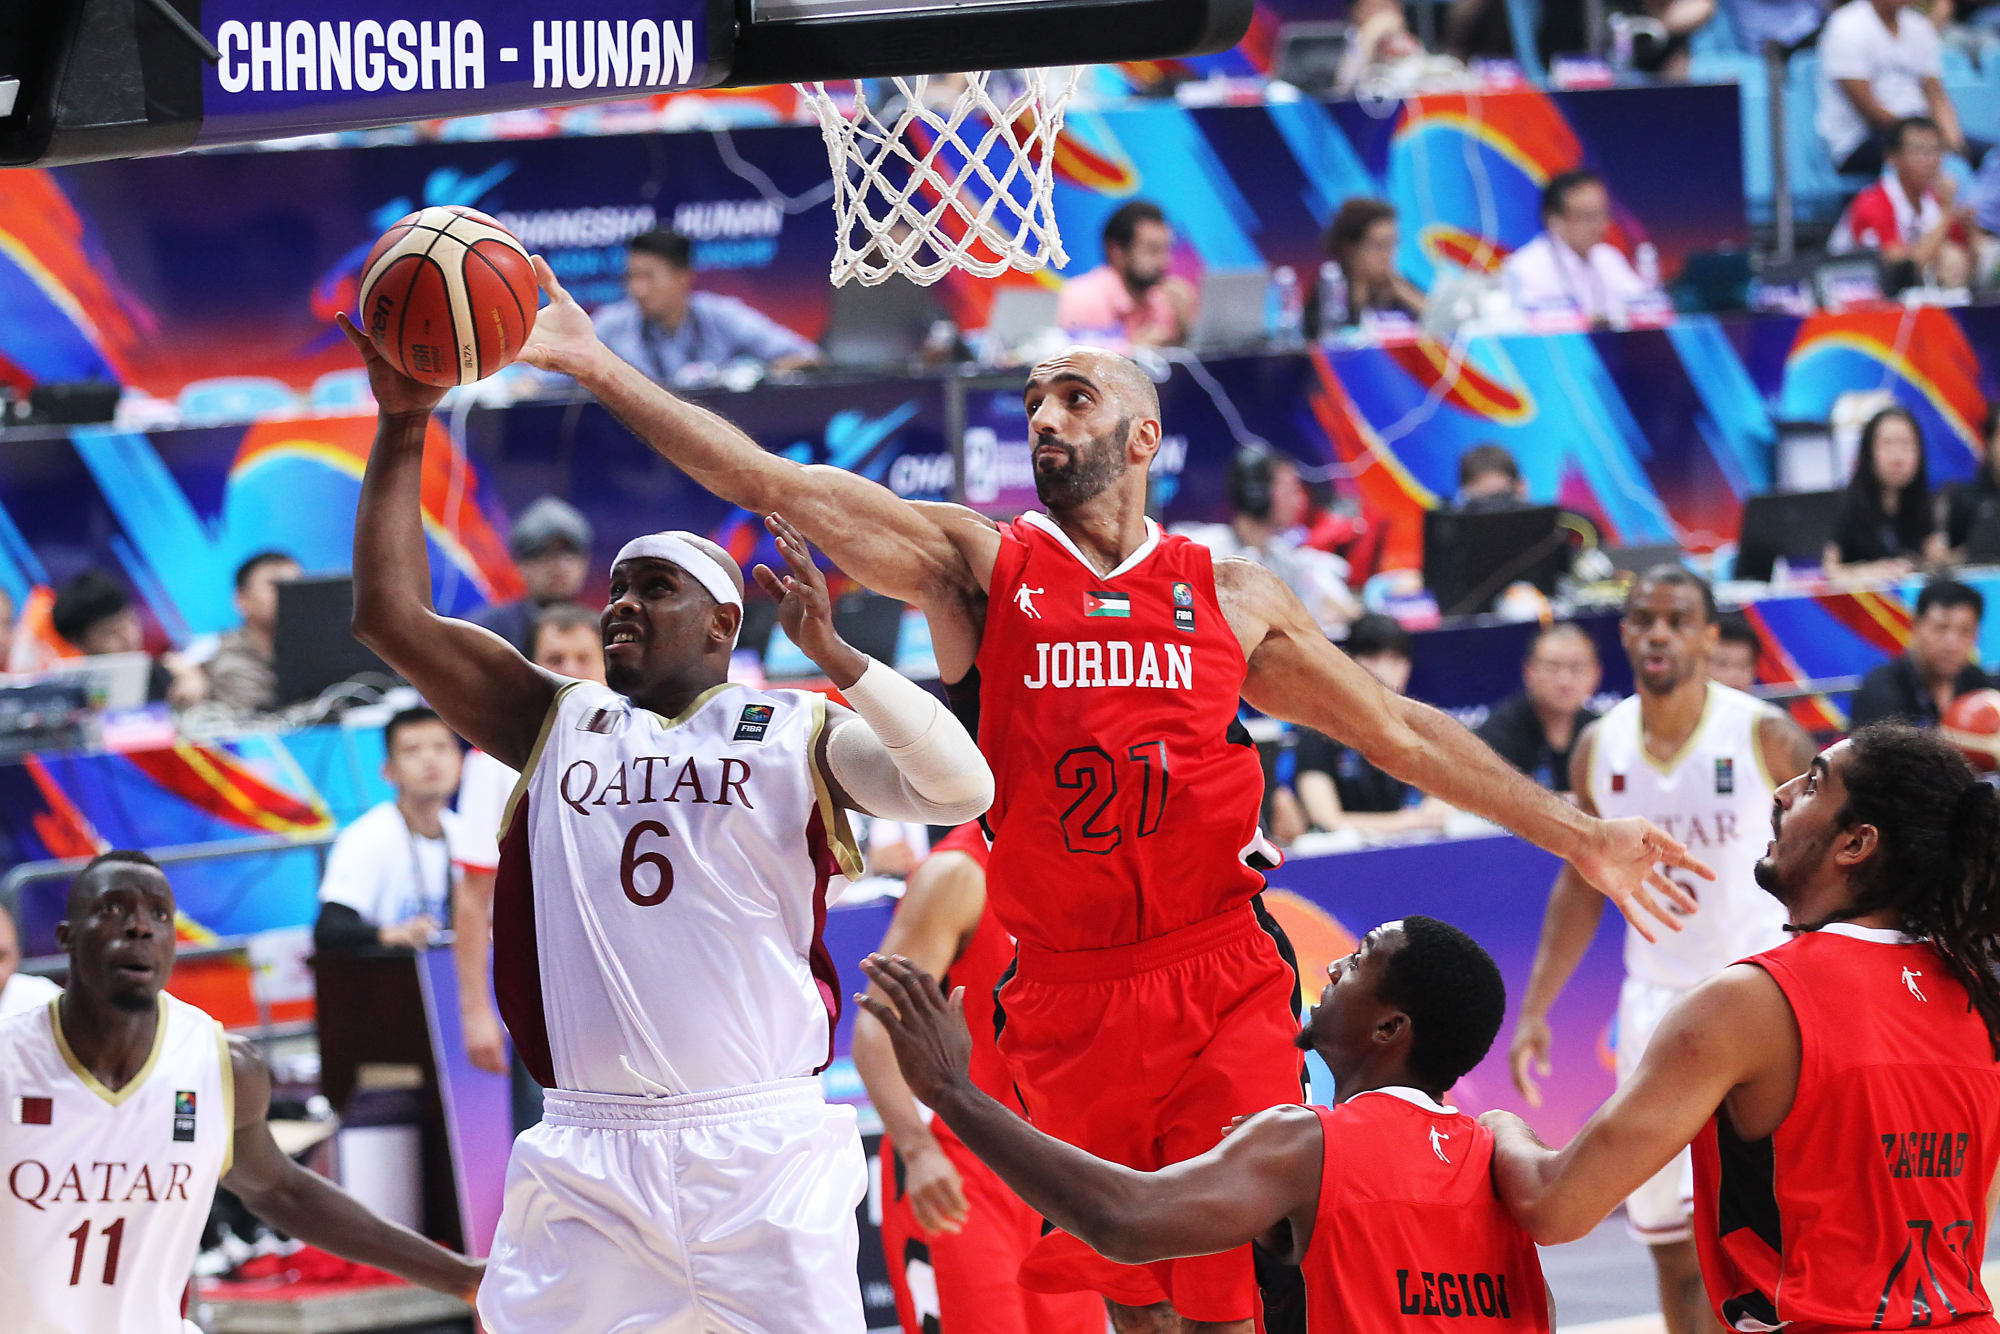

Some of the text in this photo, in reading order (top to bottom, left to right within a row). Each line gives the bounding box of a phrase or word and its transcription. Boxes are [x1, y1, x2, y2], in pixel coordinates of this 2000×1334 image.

[217, 19, 485, 93] CHANGSHA
[533, 19, 694, 89] HUNAN
[1176, 610, 1193, 620] FIBA
[1023, 640, 1193, 690] JORDAN
[560, 756, 754, 816] QATAR
[1054, 740, 1168, 855] 21
[620, 819, 674, 907] 6
[9, 1159, 192, 1211] QATAR
[1881, 1131, 1969, 1179] ZAGHAB
[68, 1217, 125, 1286] 11
